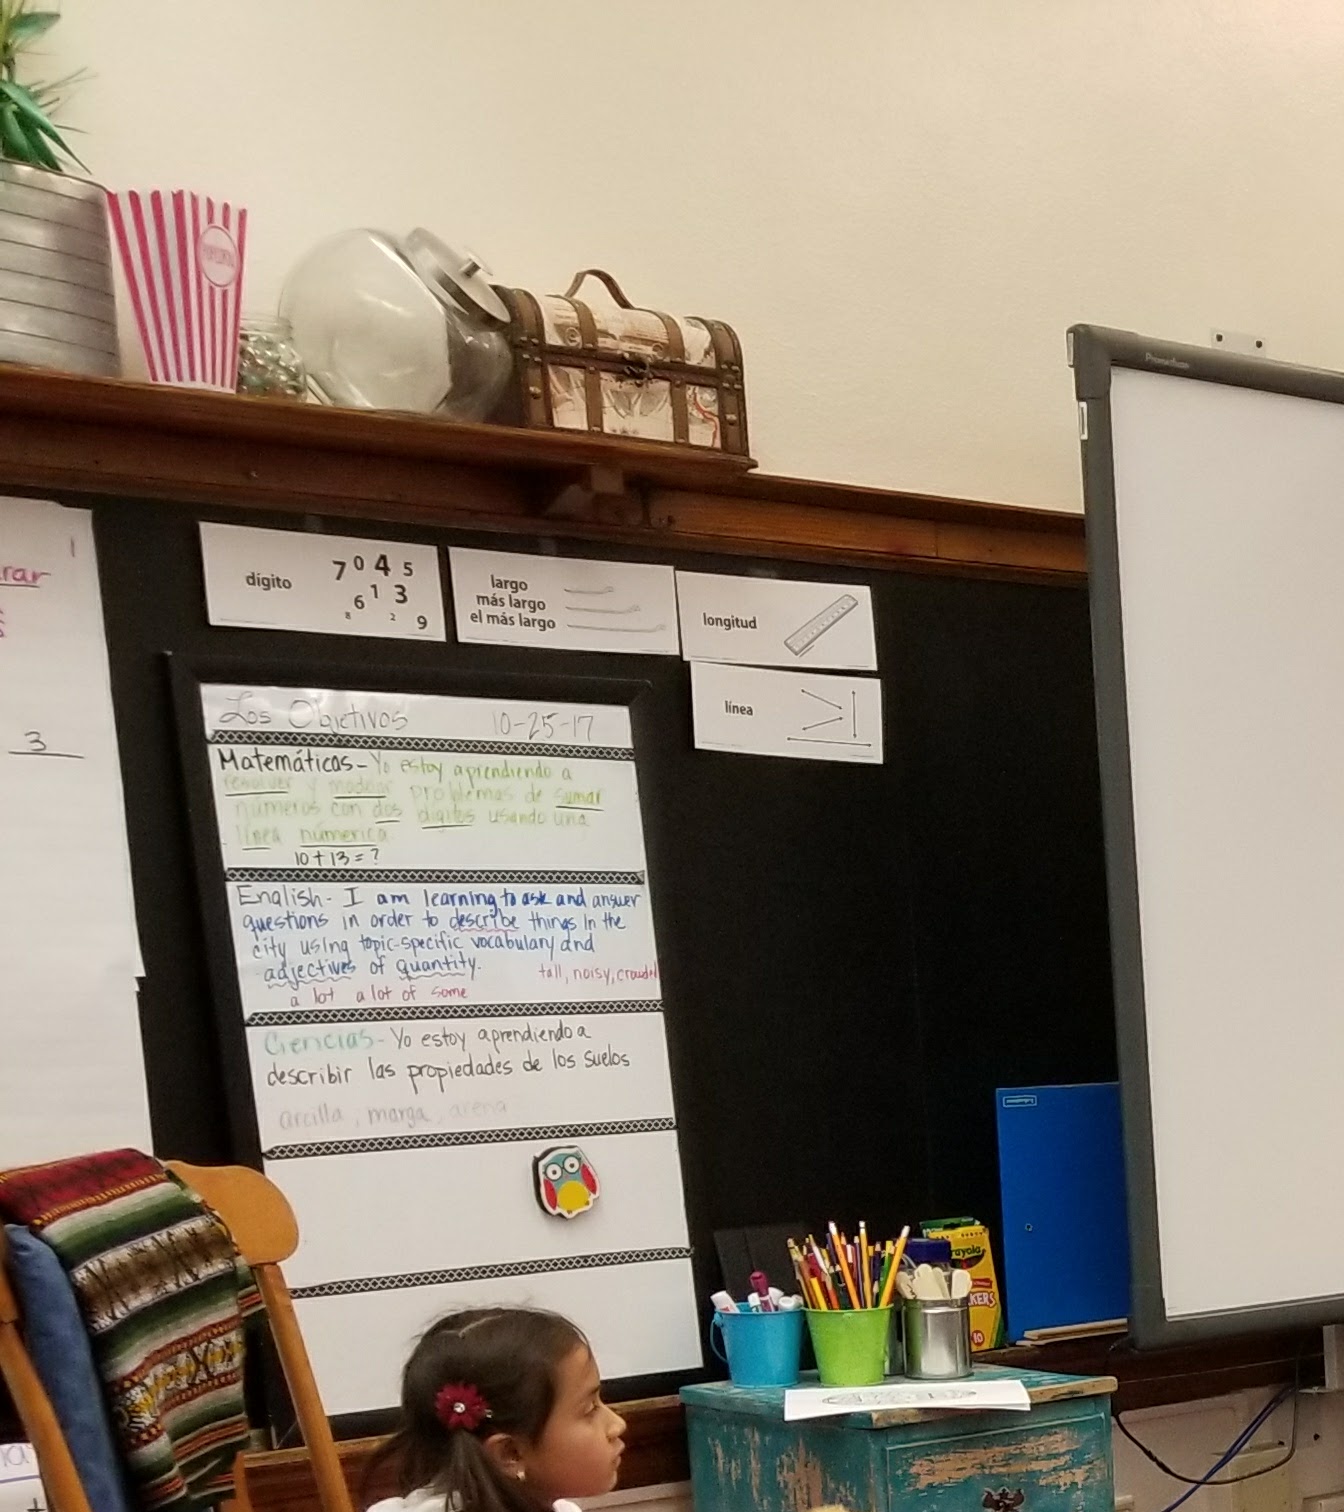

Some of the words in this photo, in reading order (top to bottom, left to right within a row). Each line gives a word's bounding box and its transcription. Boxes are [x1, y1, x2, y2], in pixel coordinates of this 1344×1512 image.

[245, 572, 292, 591] dígito
[332, 559, 347, 581] 7
[353, 554, 365, 571] 0
[374, 553, 391, 577] 4
[403, 561, 414, 577] 5
[490, 574, 528, 593] largo
[353, 595, 365, 610] 6
[370, 583, 379, 599] 1
[394, 584, 408, 604] 3
[476, 593, 505, 608] más
[508, 593, 546, 612] largo
[417, 615, 428, 629] 9
[470, 608, 483, 624] el
[486, 611, 515, 626] más
[518, 612, 556, 631] largo
[702, 612, 758, 631] longitud
[724, 700, 754, 717] línea
[376, 893, 410, 905] am
[423, 889, 497, 916] learning
[500, 888, 517, 907] to
[521, 891, 551, 905] ask
[556, 887, 587, 908] and
[592, 893, 642, 909] answer
[243, 911, 329, 941] questions
[370, 909, 413, 928] order
[423, 910, 439, 927] to
[449, 908, 518, 930] describe
[529, 911, 578, 936] things
[603, 911, 626, 930] the
[252, 937, 287, 966] city
[359, 931, 464, 960] topic-specific
[471, 934, 555, 961] vocabulary
[560, 933, 596, 953] and
[263, 961, 357, 991] adjectives
[370, 955, 386, 975] of
[313, 987, 335, 1005] lot
[356, 991, 366, 1003] a
[371, 985, 393, 1000] lot
[402, 985, 417, 1001] of
[431, 985, 469, 999] some
[390, 1027, 412, 1050] Yo
[421, 1026, 466, 1052] estoy
[477, 1019, 574, 1053] aprendiendo
[577, 1025, 591, 1039] a
[267, 1061, 353, 1087] describir
[368, 1056, 396, 1081] las
[407, 1053, 514, 1095] propiedades
[522, 1050, 543, 1072] de
[552, 1047, 576, 1070] los
[584, 1043, 631, 1068] suelos
[972, 1332, 983, 1343] 10
